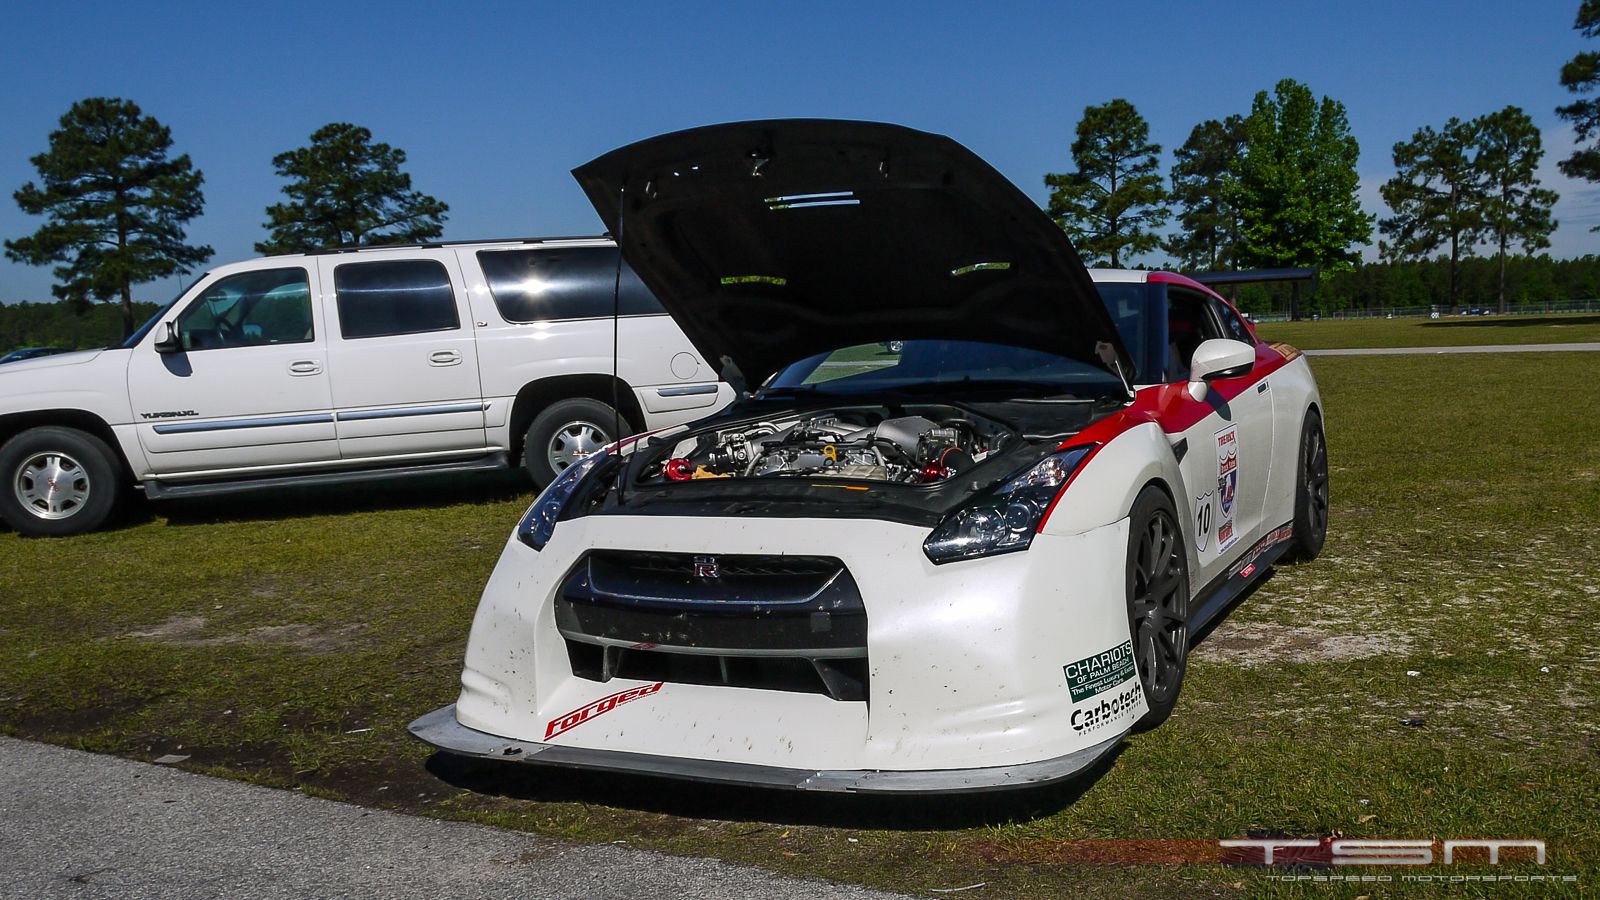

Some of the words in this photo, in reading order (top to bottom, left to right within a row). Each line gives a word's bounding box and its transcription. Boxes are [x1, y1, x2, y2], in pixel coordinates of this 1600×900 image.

[1197, 502, 1211, 537] 10
[1065, 641, 1132, 679] CHARIOTS
[1077, 674, 1088, 684] OF
[1089, 665, 1111, 680] PALM
[1112, 656, 1130, 671] BEACH
[1070, 681, 1142, 731] Carbotech
[1072, 685, 1085, 696] The
[543, 681, 665, 742] Forged
